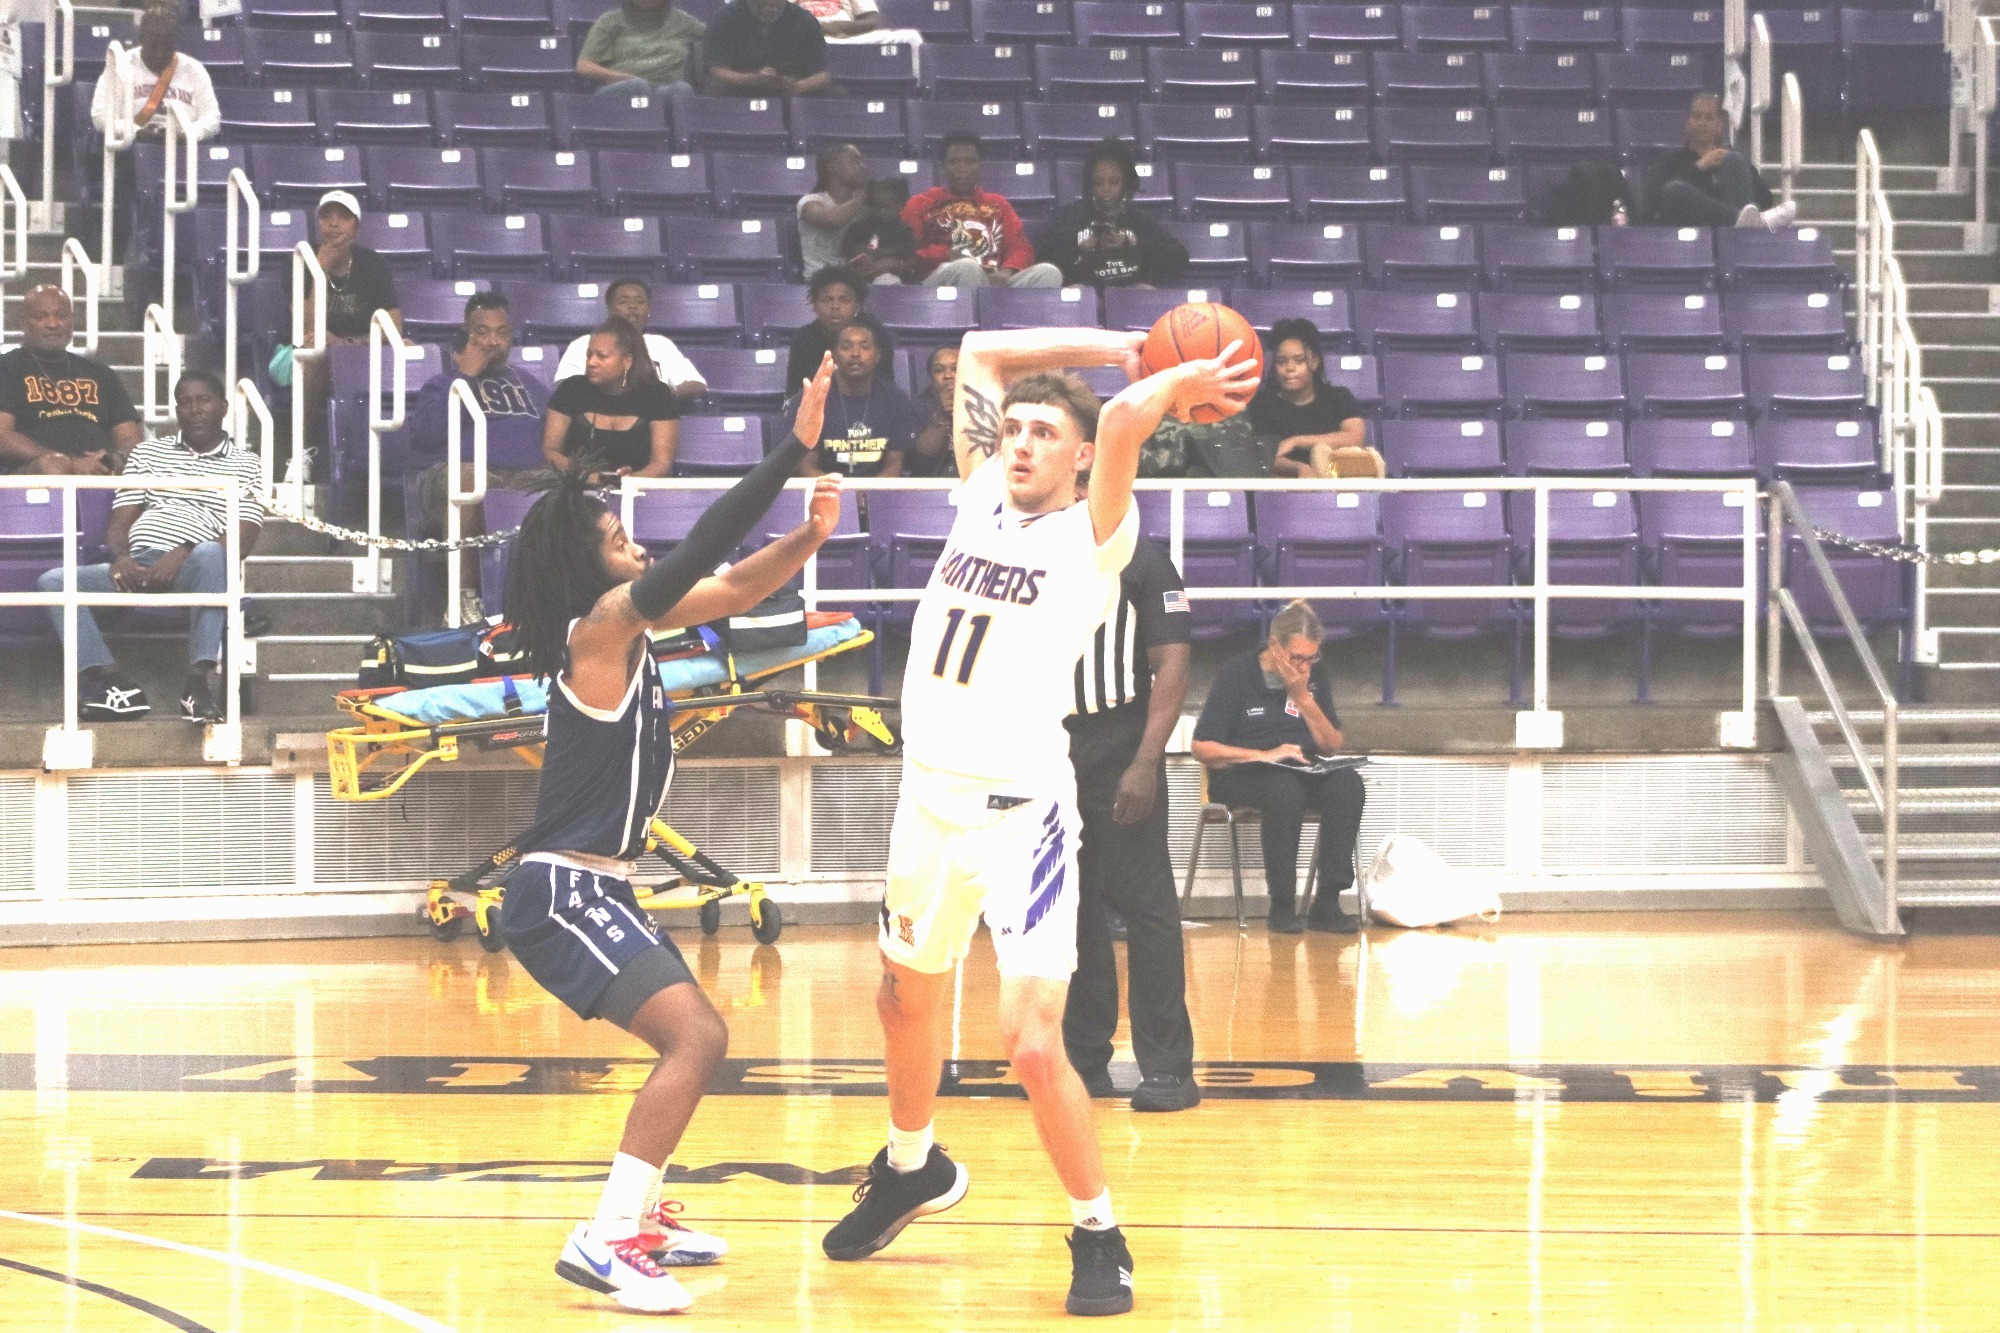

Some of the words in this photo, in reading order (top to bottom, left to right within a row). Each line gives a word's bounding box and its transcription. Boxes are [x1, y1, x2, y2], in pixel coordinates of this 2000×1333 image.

[24, 376, 99, 406] 1887
[824, 437, 888, 452] PANTHER
[940, 548, 1047, 606] ANTHERS
[932, 608, 993, 686] 11
